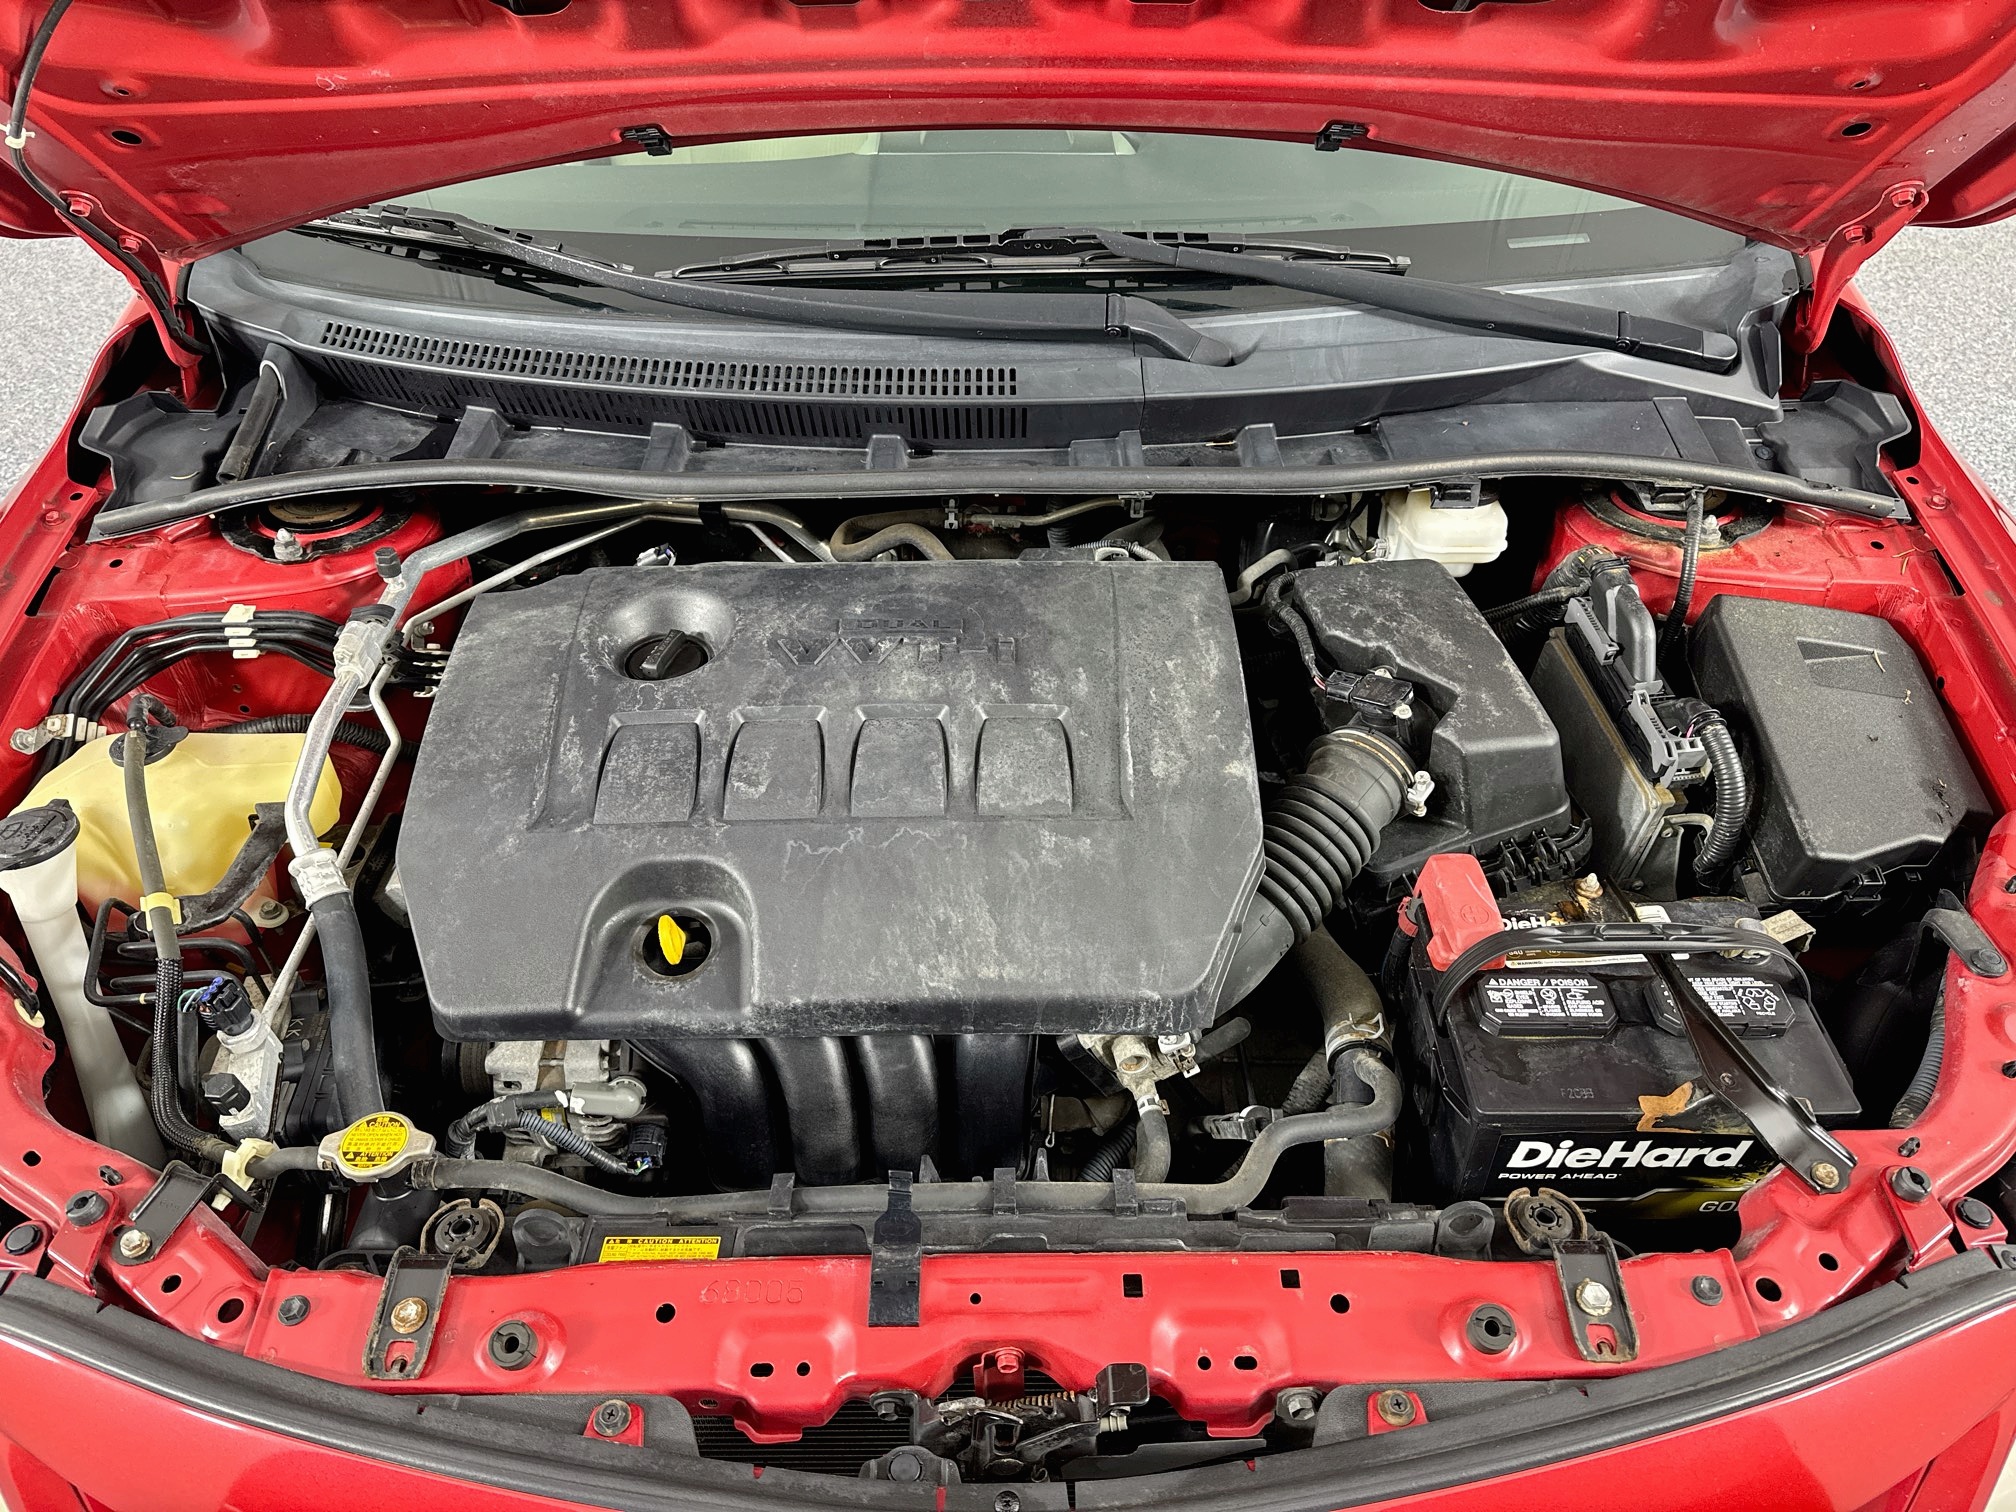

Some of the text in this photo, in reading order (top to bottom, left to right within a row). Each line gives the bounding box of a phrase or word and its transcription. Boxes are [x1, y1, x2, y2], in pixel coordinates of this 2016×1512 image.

[1498, 978, 1541, 986] DANGER
[1550, 978, 1589, 986] POISON
[1506, 1139, 1754, 1168] DieHard
[1498, 1172, 1556, 1180] POWER
[699, 1279, 804, 1304] 68005
